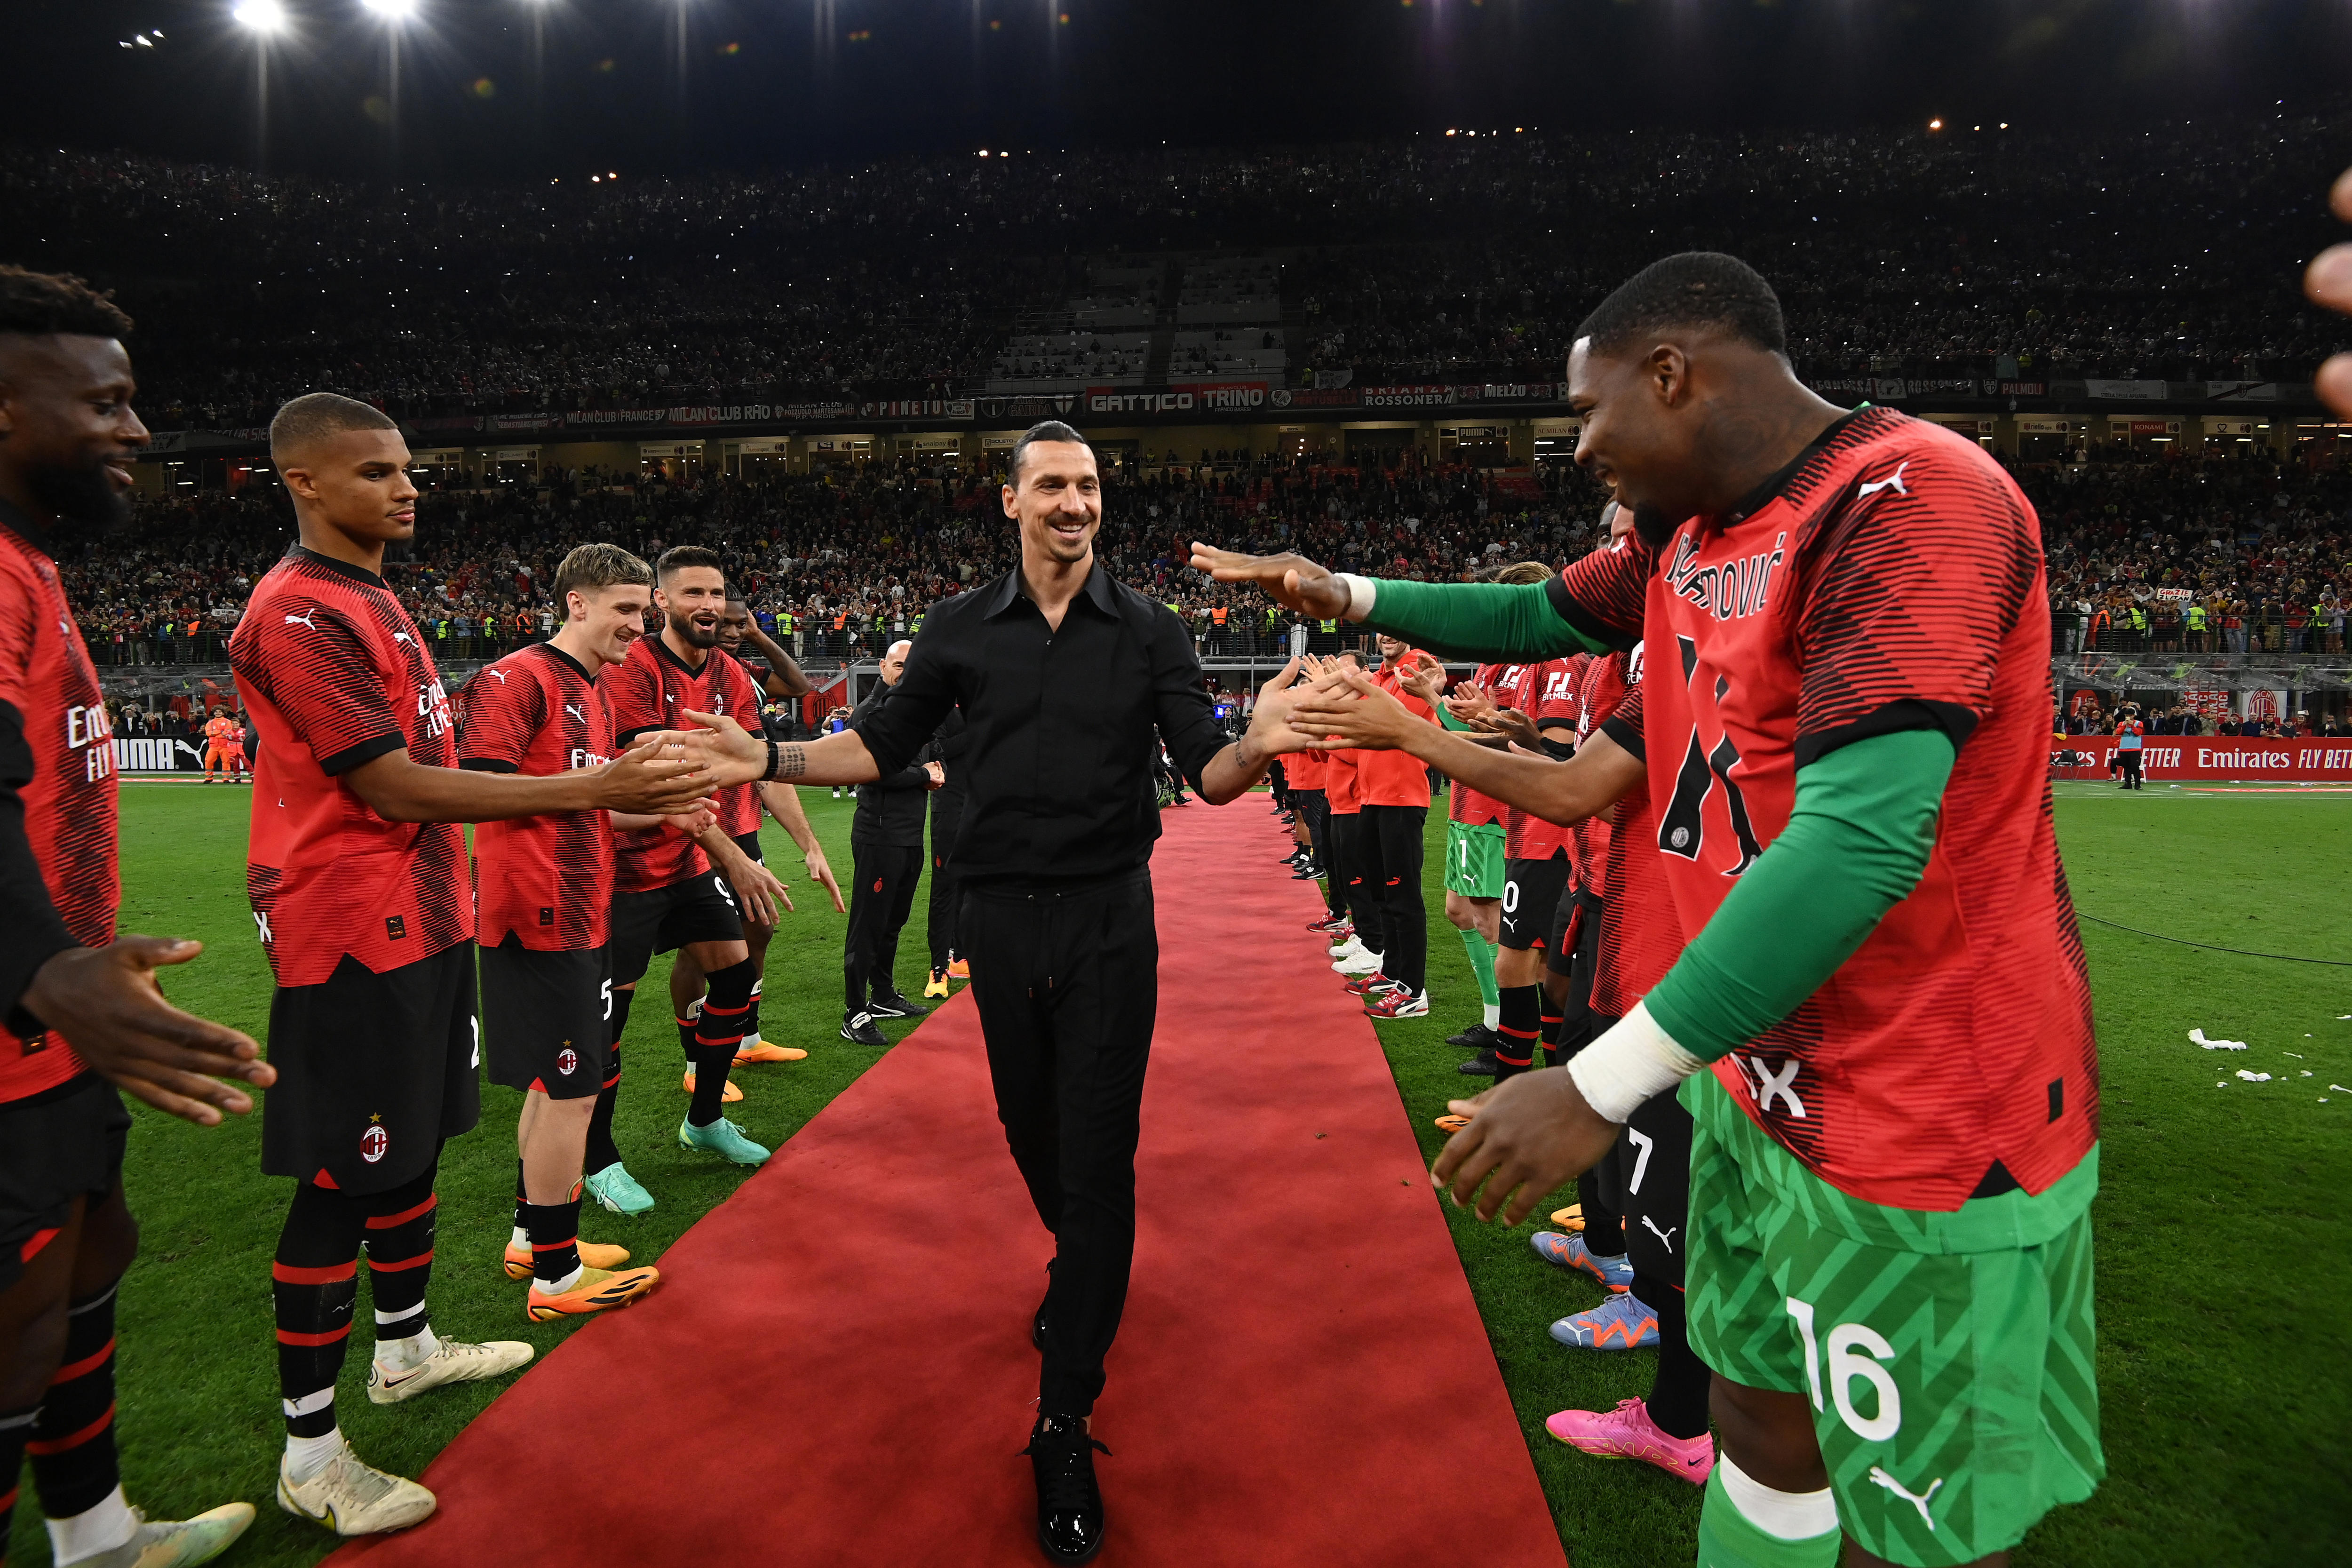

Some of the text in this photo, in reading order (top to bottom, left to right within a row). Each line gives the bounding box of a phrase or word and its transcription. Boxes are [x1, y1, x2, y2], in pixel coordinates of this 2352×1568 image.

[1485, 385, 1526, 398] MELZO
[2003, 382, 2042, 395] PALMOLI
[1091, 393, 1193, 413] GATTICO
[1203, 389, 1263, 407] TRINO
[668, 405, 771, 422] MILAN CLUB RHO
[879, 400, 940, 415] PINETO
[1008, 404, 1052, 416] GARDA
[566, 411, 593, 424] MILAN
[595, 411, 617, 423] CLUB
[620, 410, 654, 422] FRANCE
[1461, 428, 1485, 437] PUMA
[1498, 680, 1518, 690] BitME
[1542, 692, 1573, 702] BitMEX
[2254, 691, 2272, 700] ACM
[111, 739, 175, 769] UMA
[2140, 748, 2181, 768] ETTER
[2198, 747, 2290, 769] Emirates
[2298, 749, 2322, 768] FLY
[1459, 839, 1467, 868] 1
[367, 1127, 383, 1137] ACM
[1629, 1126, 1653, 1195] 7
[1786, 1297, 1901, 1441] 16
